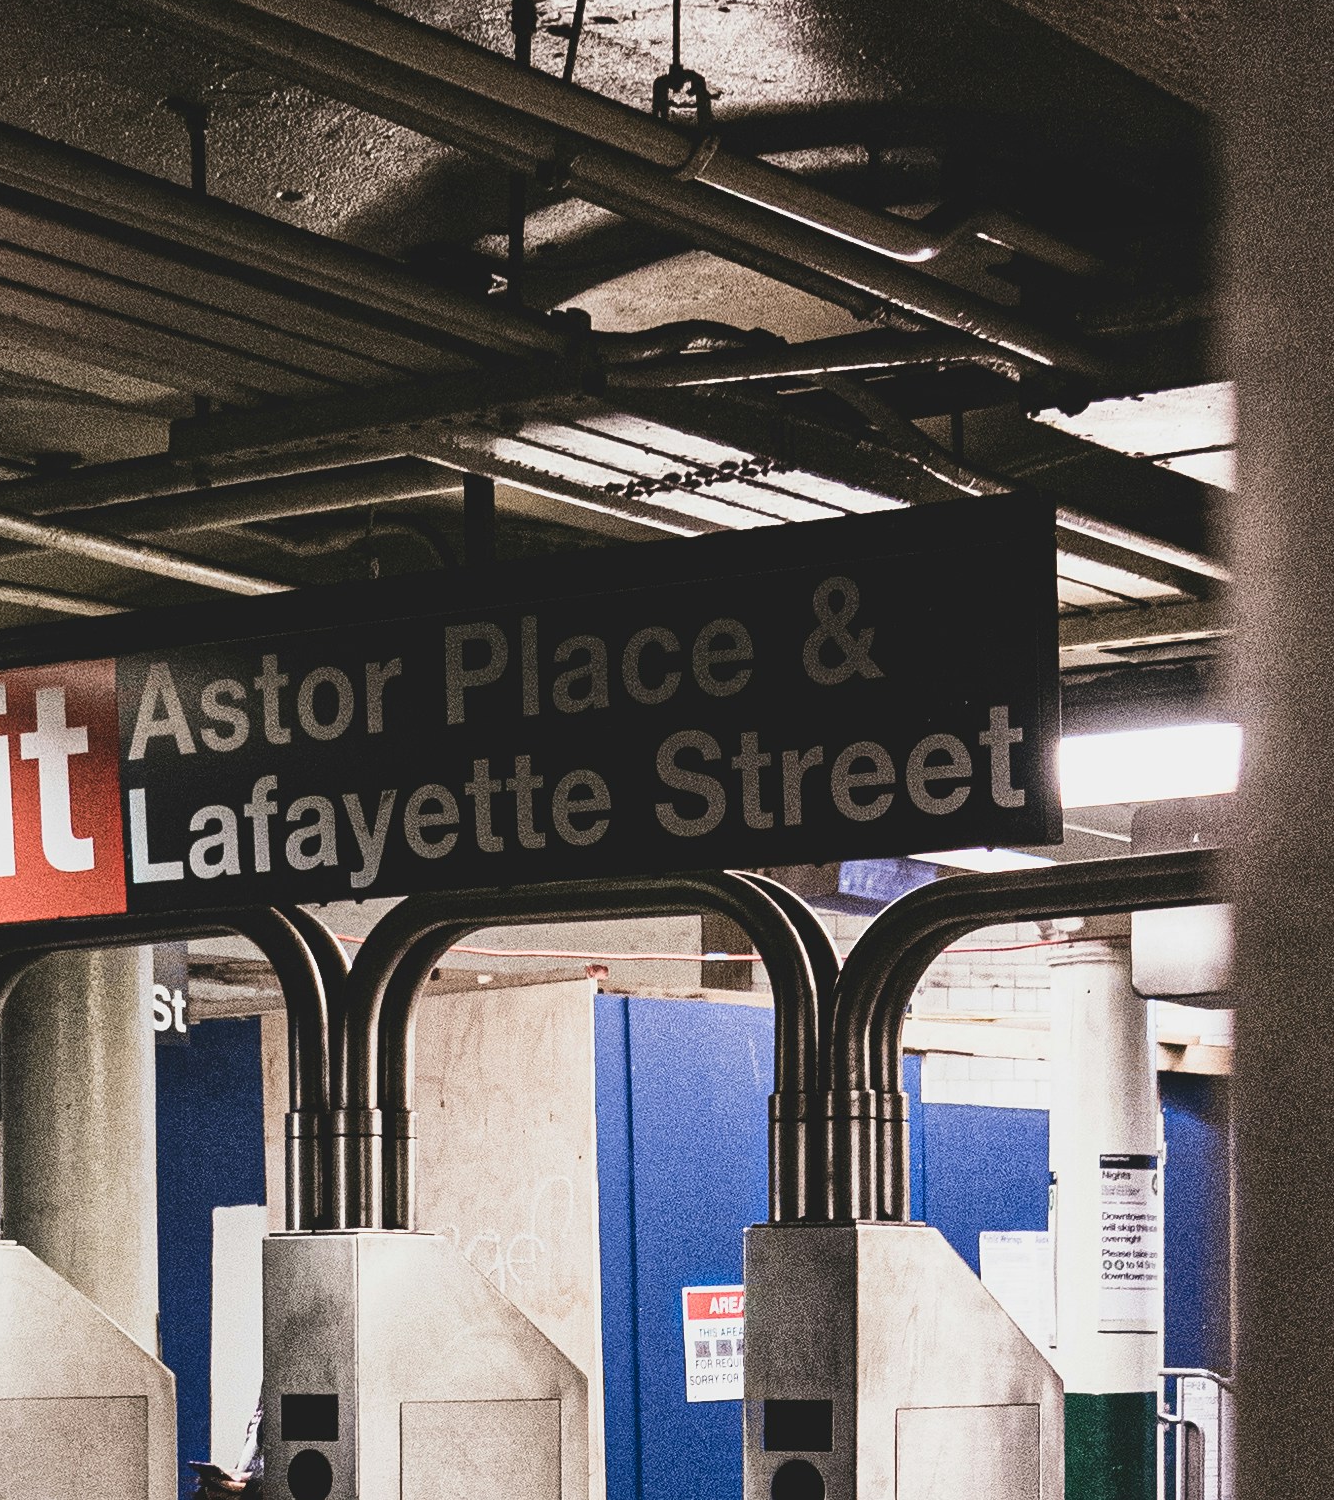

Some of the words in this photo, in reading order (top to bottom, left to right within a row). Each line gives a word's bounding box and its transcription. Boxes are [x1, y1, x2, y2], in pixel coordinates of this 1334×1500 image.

[128, 653, 402, 760] Astor
[443, 617, 755, 726] Place
[802, 576, 886, 686] &
[128, 753, 612, 888] Lafayette
[655, 705, 1026, 838] Street
[152, 984, 187, 1033] St
[699, 1328, 718, 1338] THIS
[689, 1374, 720, 1386] SORRY
[722, 1373, 739, 1384] FOR
[695, 1360, 713, 1370] FOR
